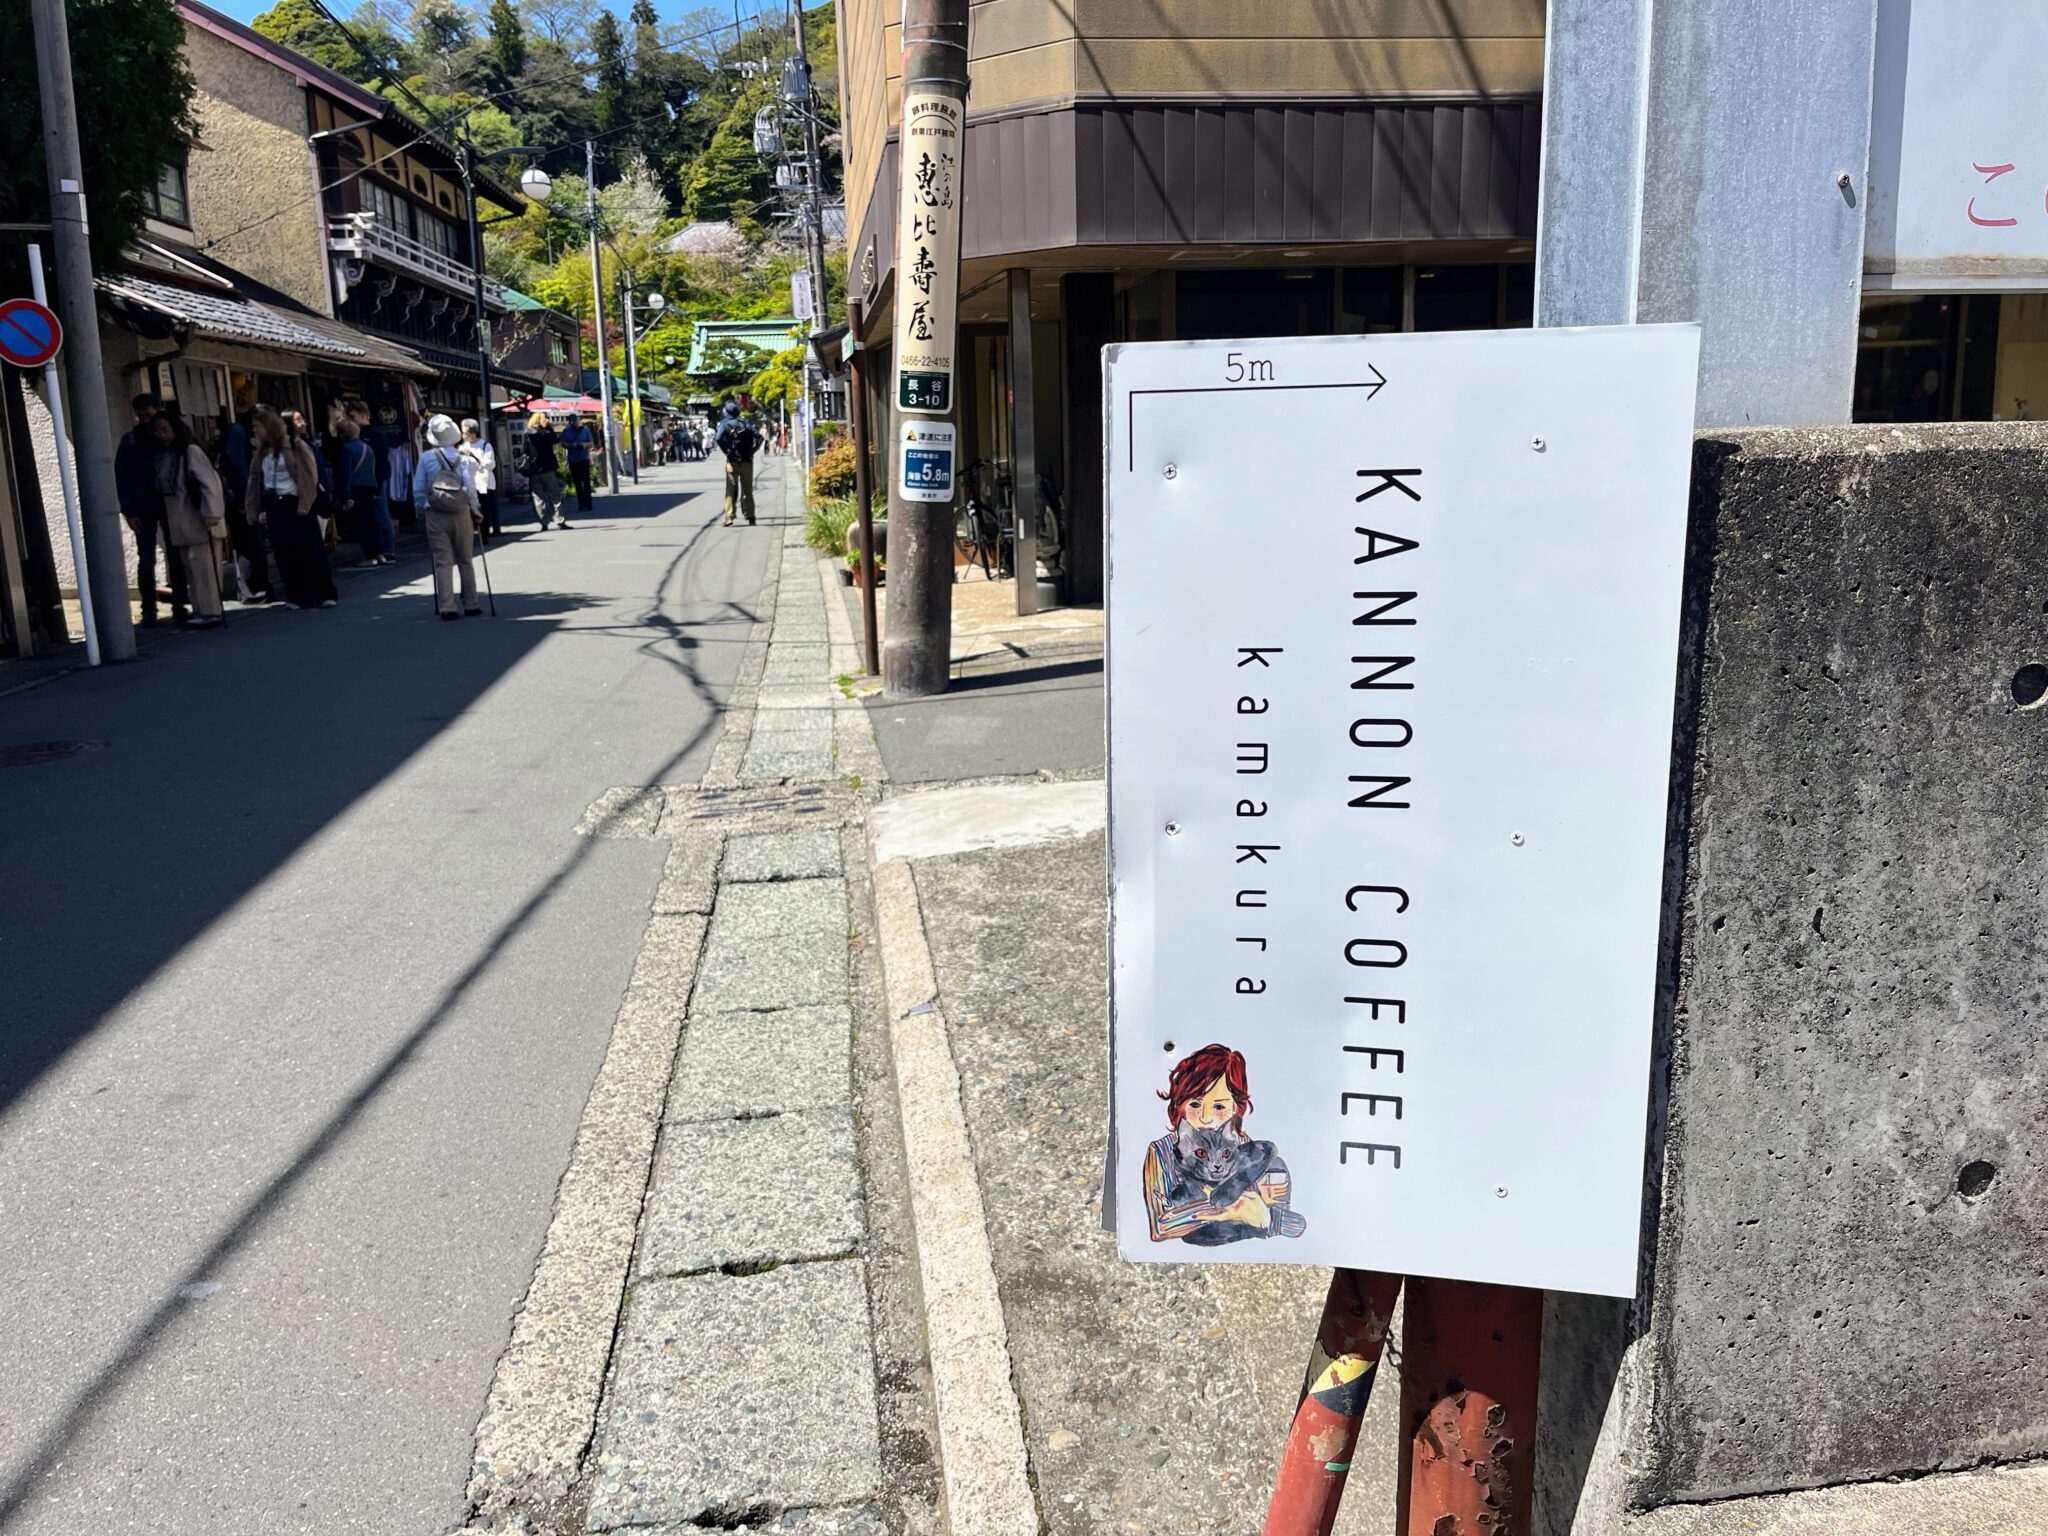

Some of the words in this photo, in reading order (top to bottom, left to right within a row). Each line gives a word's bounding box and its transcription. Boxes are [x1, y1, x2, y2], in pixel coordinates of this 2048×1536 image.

[941, 153, 955, 210] 江の島
[1967, 163, 2048, 227] こ
[908, 393, 940, 406] 3-10
[1225, 353, 1275, 382] 5m
[1347, 468, 1423, 809] KANNON
[1235, 647, 1284, 995] kamakura
[1339, 884, 1410, 1170] COFFEE
